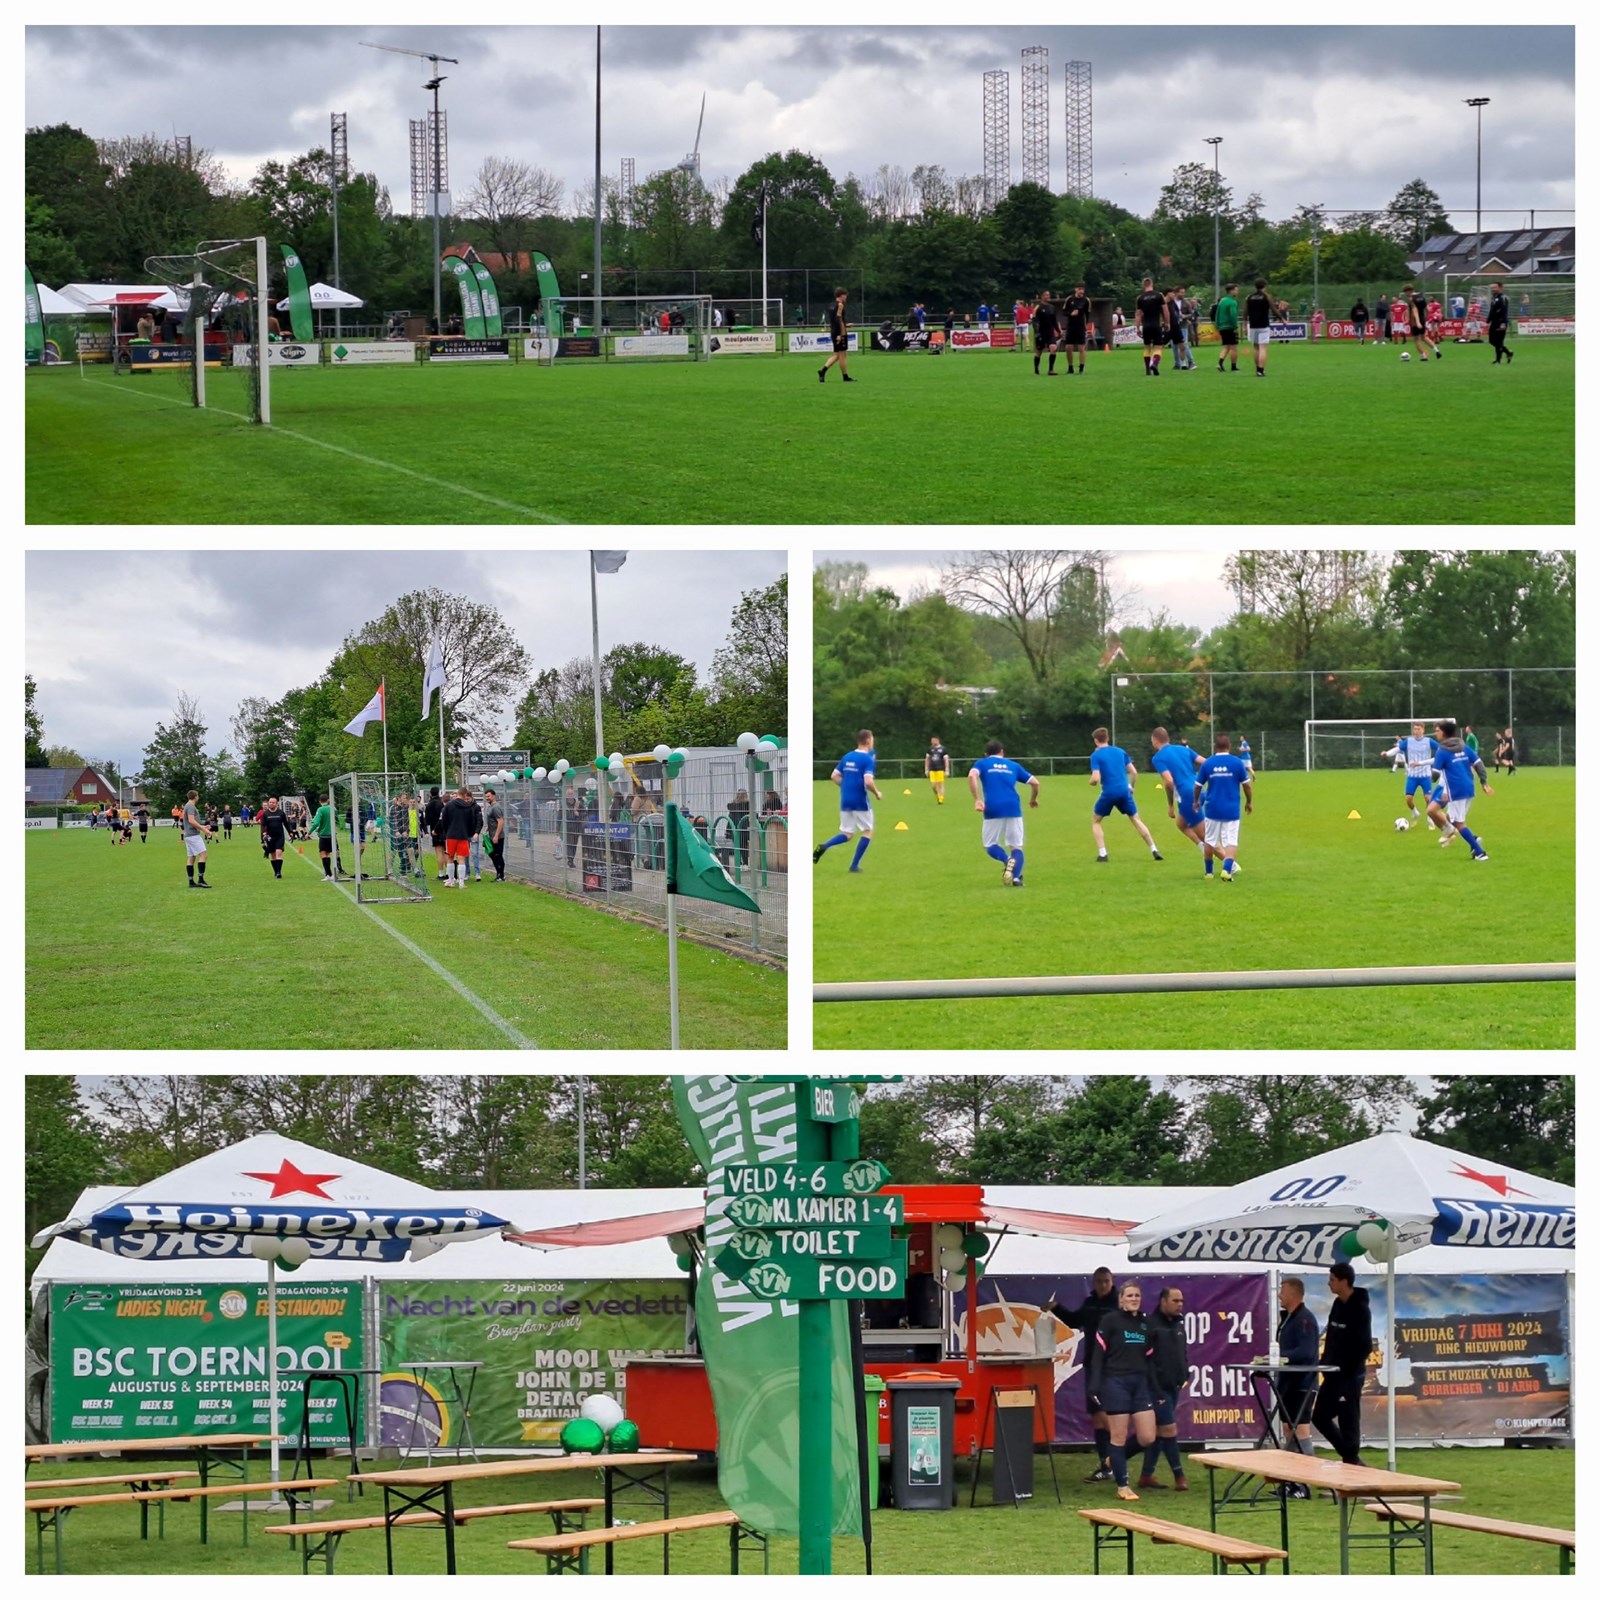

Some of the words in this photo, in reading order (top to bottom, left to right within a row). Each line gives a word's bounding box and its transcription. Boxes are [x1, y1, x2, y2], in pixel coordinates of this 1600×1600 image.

[814, 1087, 835, 1117] BIER
[727, 1168, 778, 1193] VELD
[123, 1205, 480, 1243] Heineken
[776, 1230, 861, 1255] TOILET
[503, 1283, 515, 1292] 22
[537, 1283, 565, 1292] 2024
[818, 1264, 897, 1294] FOOD
[118, 1287, 183, 1297] VRIJDAGAVOND
[257, 1287, 329, 1296] ZARDAGAVOND
[115, 1300, 162, 1317] LADIES
[163, 1299, 206, 1316] NIGHT
[255, 1299, 346, 1317] FESTAVOND!
[385, 1294, 478, 1317] Nacht
[481, 1300, 537, 1316] van
[542, 1294, 580, 1316] de
[584, 1294, 686, 1316] vedett
[485, 1319, 549, 1342] Brazilian
[547, 1314, 583, 1337] party
[1123, 1330, 1146, 1340] beko
[1401, 1325, 1454, 1343] VRIJDAG
[1458, 1325, 1467, 1341] 7
[1469, 1323, 1504, 1340] JUNI
[1507, 1320, 1543, 1337] 2024
[1435, 1342, 1461, 1355] RING
[1465, 1340, 1528, 1354] NIEUWDORP
[73, 1347, 135, 1377] BSC
[147, 1345, 342, 1377] TOERNOOI
[535, 1349, 598, 1368] MOOI
[515, 1371, 571, 1388] JOHN
[579, 1371, 606, 1388] DE
[1427, 1370, 1446, 1381] MET
[1449, 1368, 1489, 1381] MUZIEK
[1490, 1367, 1514, 1379] VAN
[109, 1381, 177, 1393] AUGUSTUS
[181, 1381, 192, 1393] &
[195, 1380, 270, 1393] SEPTEMBER
[274, 1380, 304, 1392] 2024
[1188, 1369, 1213, 1398] 26
[1421, 1383, 1483, 1396] SURRENDER
[1497, 1381, 1509, 1393] DJ
[1511, 1379, 1541, 1392] ARNO
[82, 1399, 103, 1410] WEEK
[140, 1400, 162, 1410] WEEK
[198, 1399, 220, 1410] WEEK
[517, 1408, 579, 1418] BRAZILIAN
[1193, 1408, 1256, 1425] KLOMPPOP.NL
